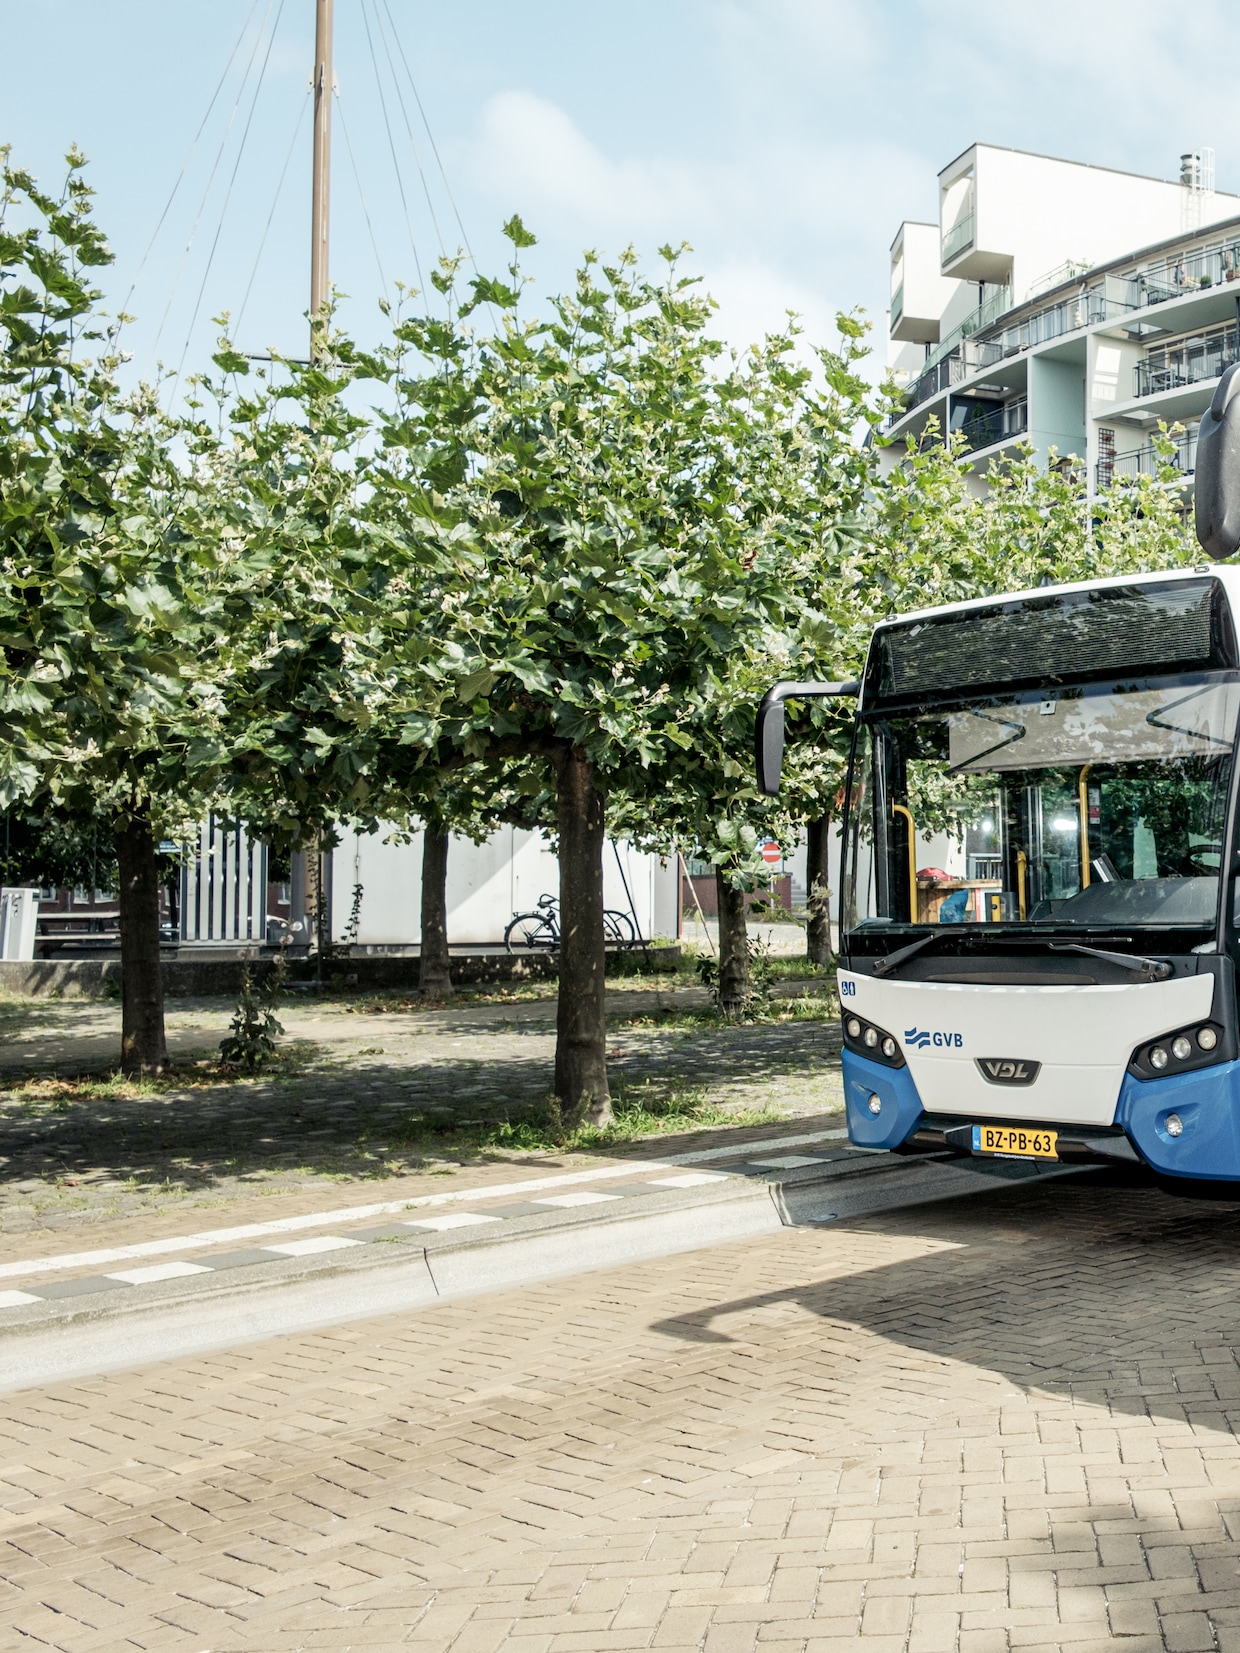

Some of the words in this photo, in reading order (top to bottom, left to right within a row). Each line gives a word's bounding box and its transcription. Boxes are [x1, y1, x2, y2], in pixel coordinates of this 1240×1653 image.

[933, 1032, 963, 1047] GVB
[985, 1062, 1029, 1078] VDL
[986, 1130, 1051, 1152] BZ-PB-63
